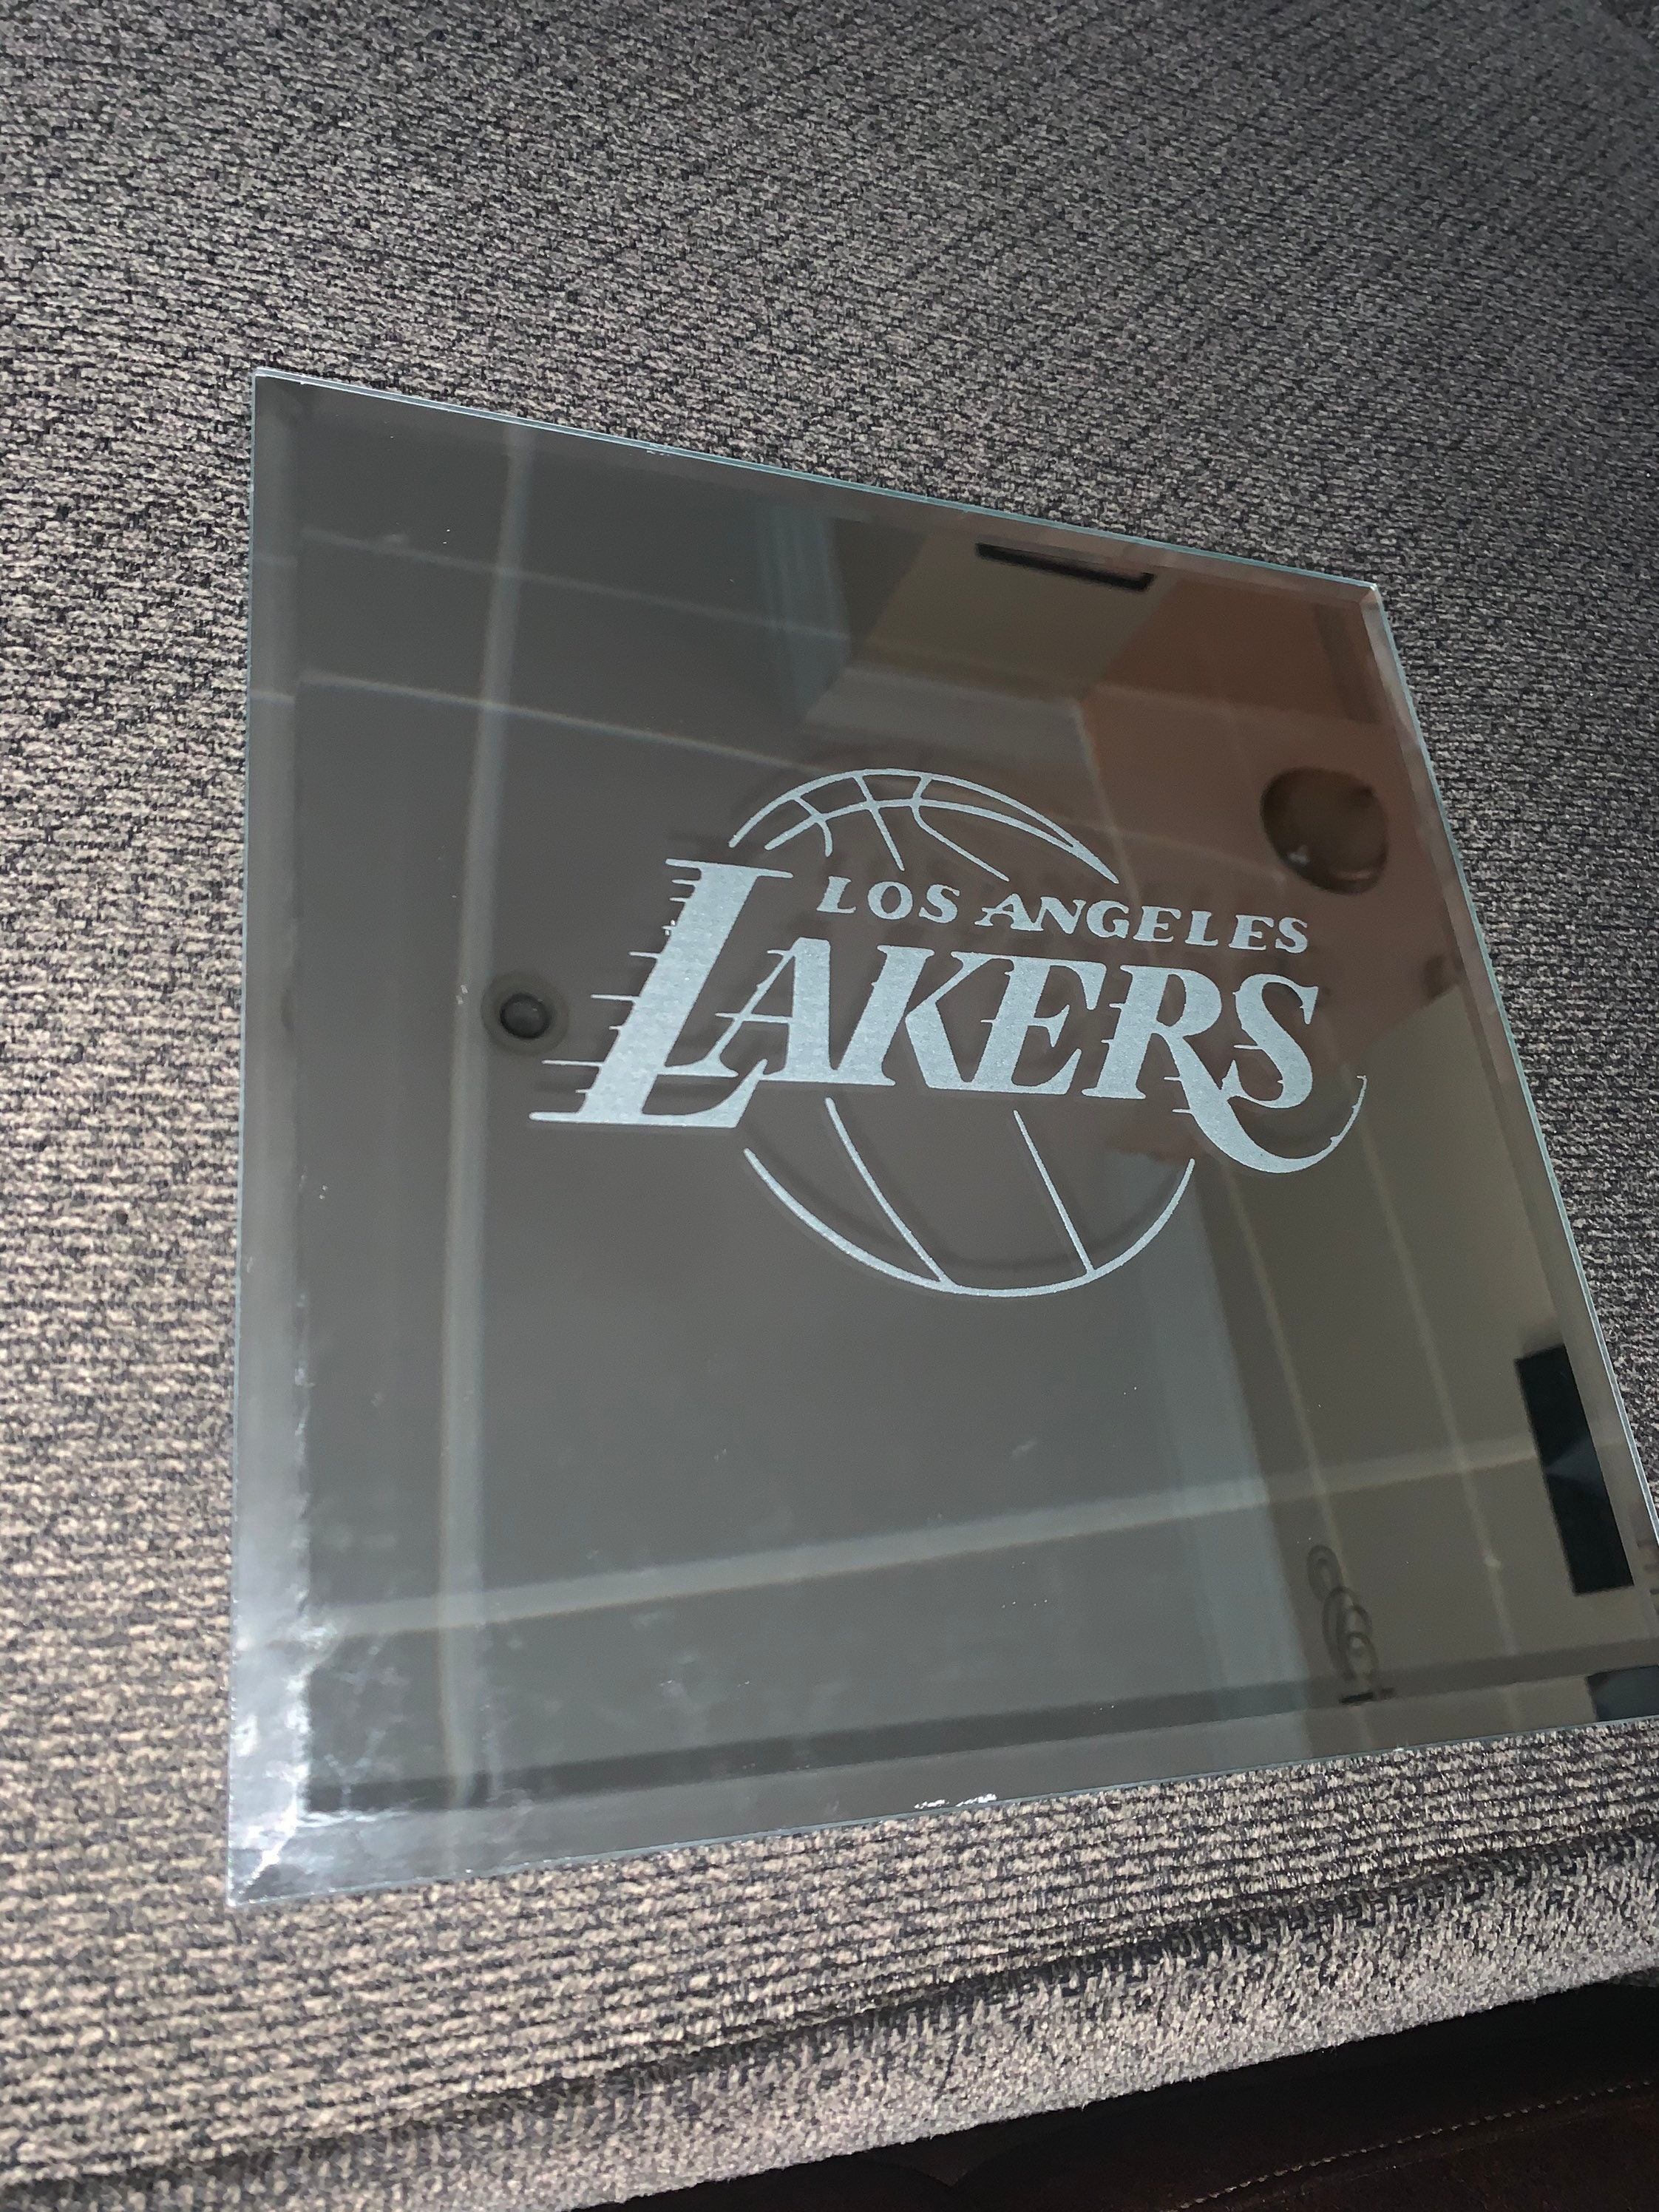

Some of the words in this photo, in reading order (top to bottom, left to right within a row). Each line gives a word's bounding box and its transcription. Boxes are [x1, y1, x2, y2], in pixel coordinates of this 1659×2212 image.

[816, 875, 960, 924] LOS
[974, 893, 1309, 954] ANGELES
[528, 858, 1368, 1174] LAKERS
